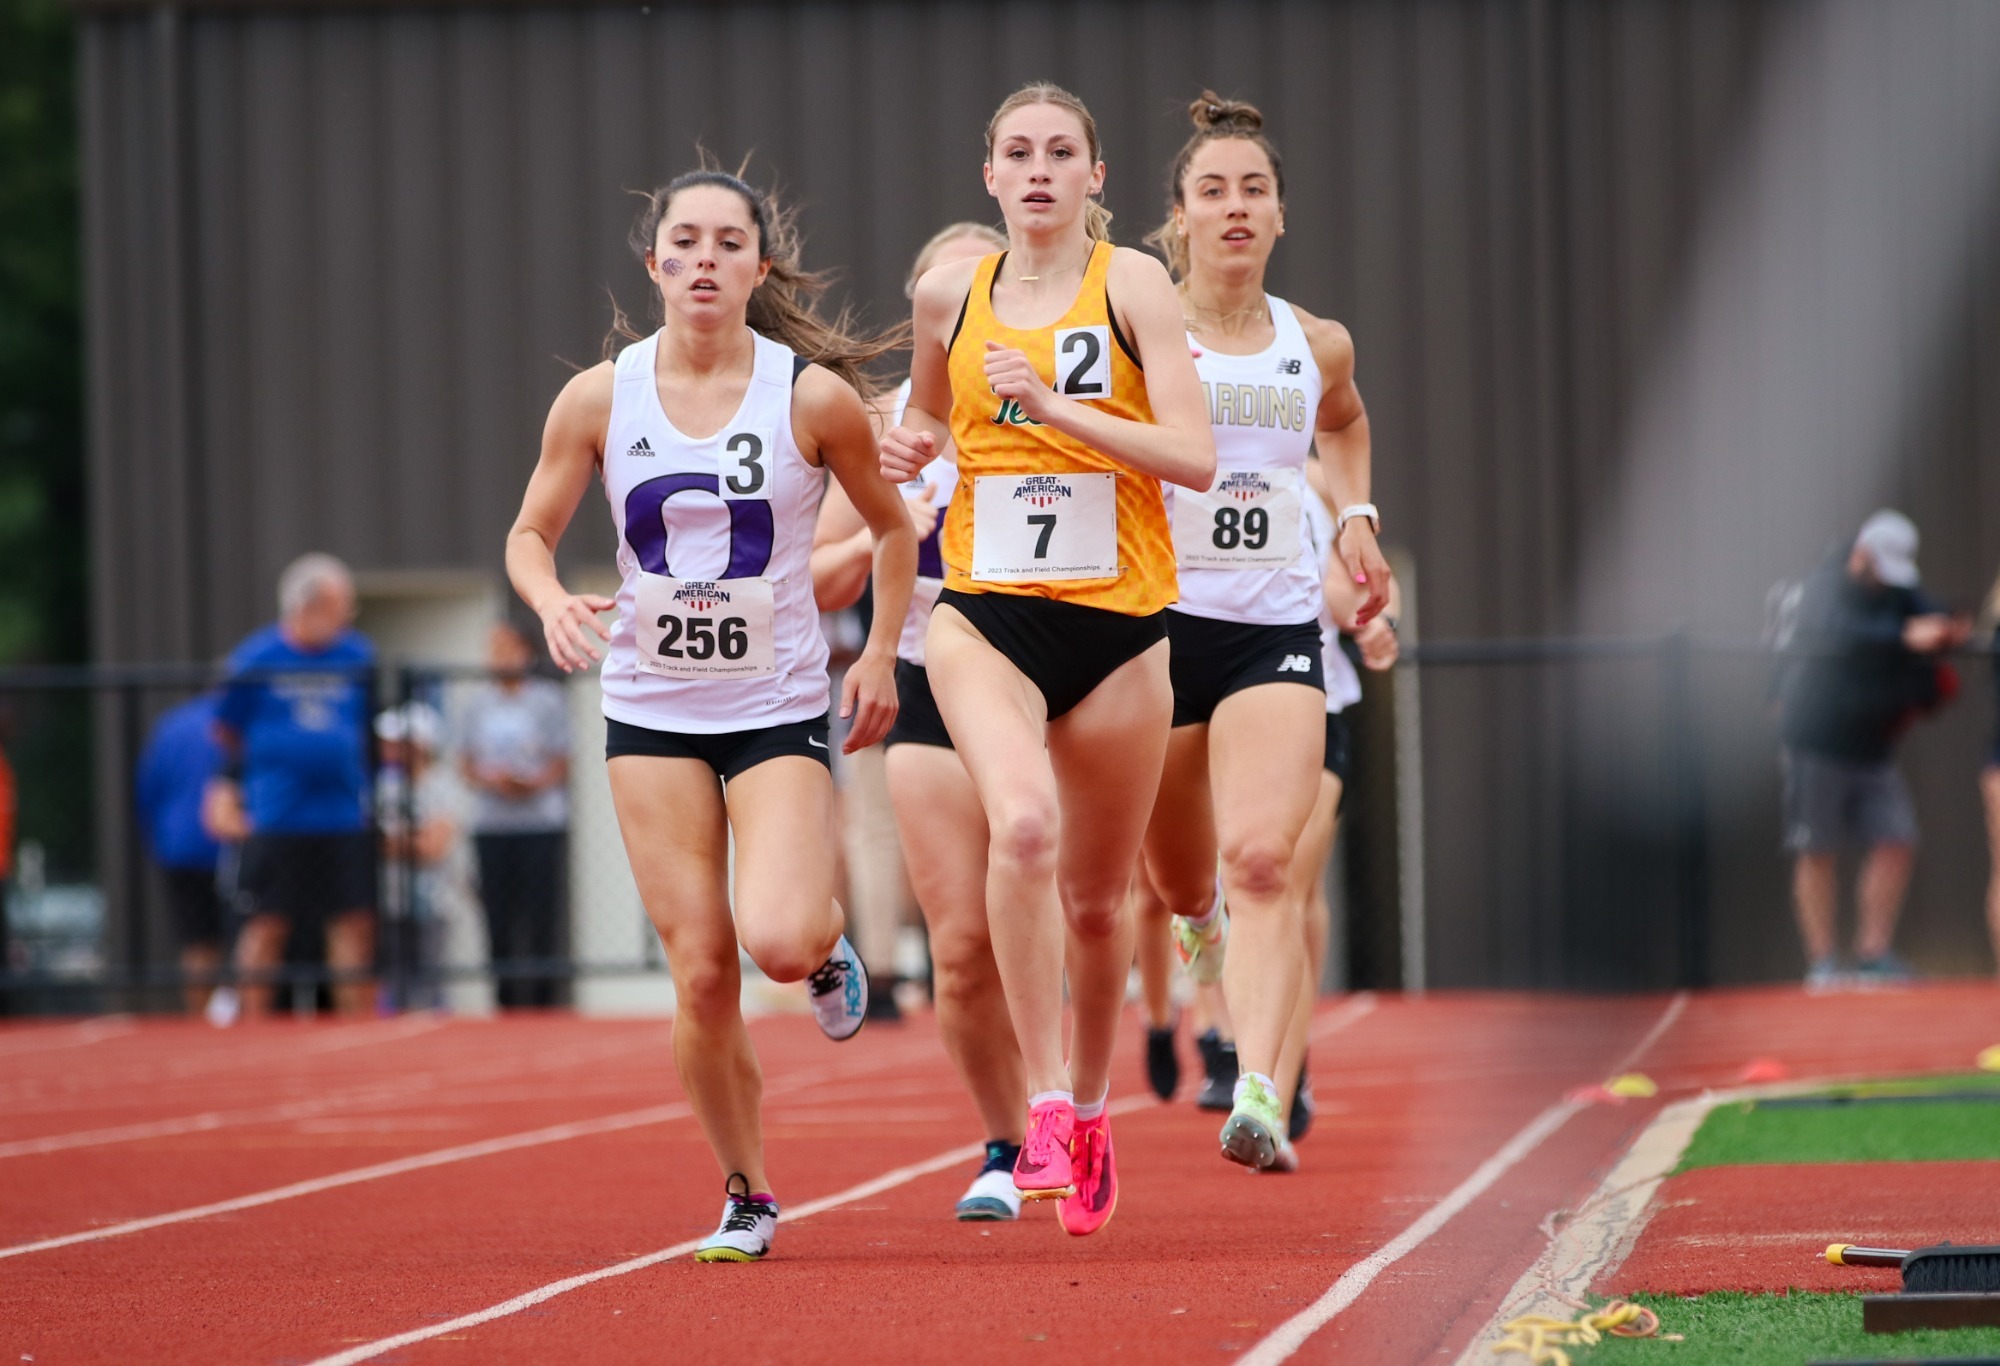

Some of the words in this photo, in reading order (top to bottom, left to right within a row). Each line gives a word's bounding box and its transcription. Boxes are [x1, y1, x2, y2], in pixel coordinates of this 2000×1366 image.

[1062, 331, 1103, 395] 2
[626, 449, 655, 457] adidas
[725, 433, 765, 495] 3
[1025, 476, 1057, 485] GREAT
[1231, 472, 1260, 480] GREAT
[1013, 485, 1072, 499] AMERICAN
[1217, 480, 1271, 493] AMERICAN
[1212, 507, 1268, 550] 89
[1027, 514, 1057, 559] 7
[1052, 564, 1101, 573] Championships
[685, 582, 716, 590] GREAT
[672, 589, 731, 603] AMERICAN
[657, 614, 748, 660] 256
[663, 663, 678, 671] Track
[709, 665, 758, 673] Championships
